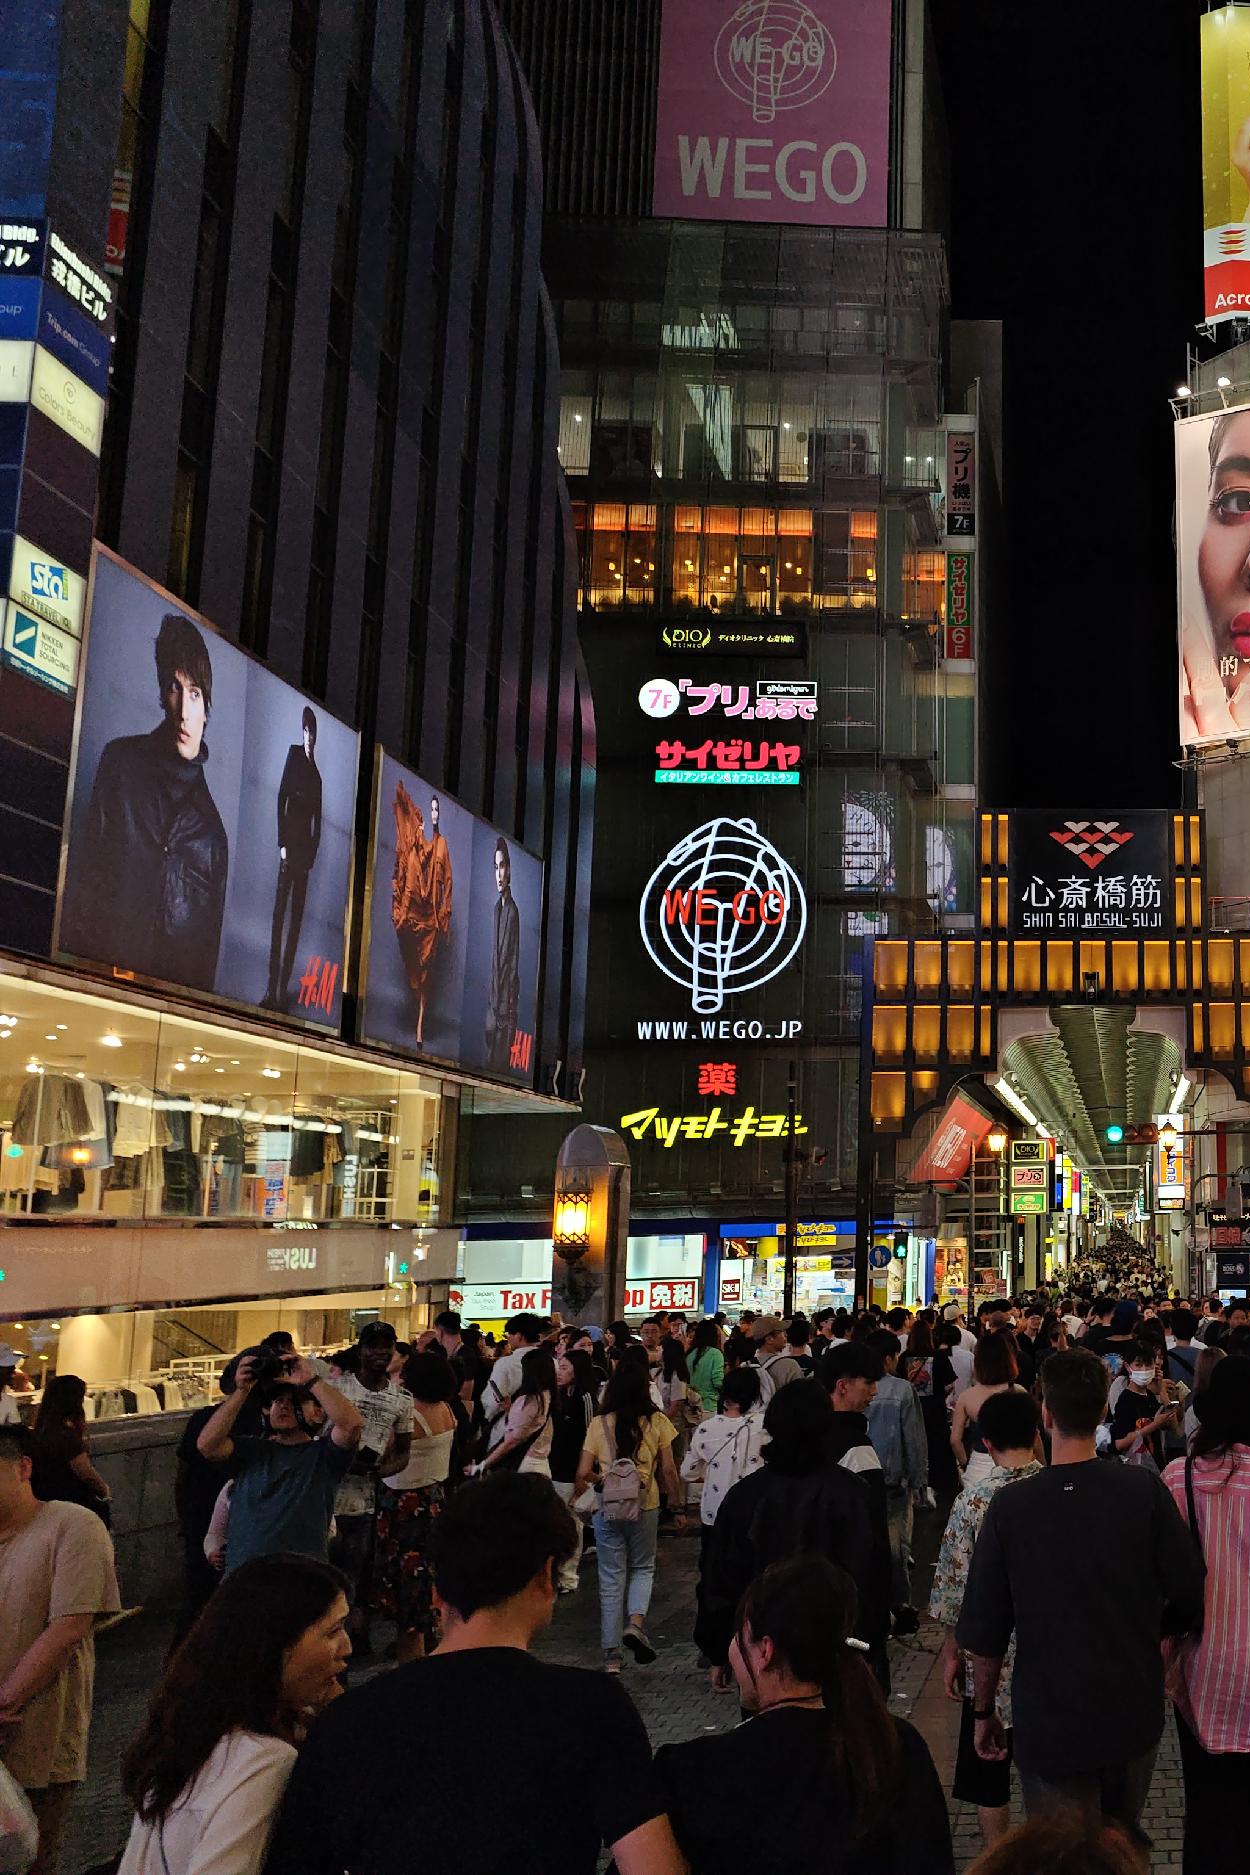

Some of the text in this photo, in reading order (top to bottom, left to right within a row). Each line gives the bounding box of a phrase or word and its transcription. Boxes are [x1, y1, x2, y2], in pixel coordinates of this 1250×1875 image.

[677, 134, 868, 204] WEGO
[952, 449, 971, 500] プリ機
[954, 515, 970, 530] 7F
[952, 557, 968, 624] サイゼリヤ
[673, 629, 702, 642] DIO
[649, 690, 673, 710] 7F
[655, 739, 801, 771] サイゼリヤ
[1021, 875, 1163, 909] 心斎橋筋
[1023, 912, 1053, 928] SHIN
[637, 1020, 803, 1040] WWW.WEGO.JP
[699, 1063, 737, 1096] 薬
[500, 1289, 537, 1310] Tax
[651, 1284, 694, 1308] 免税
